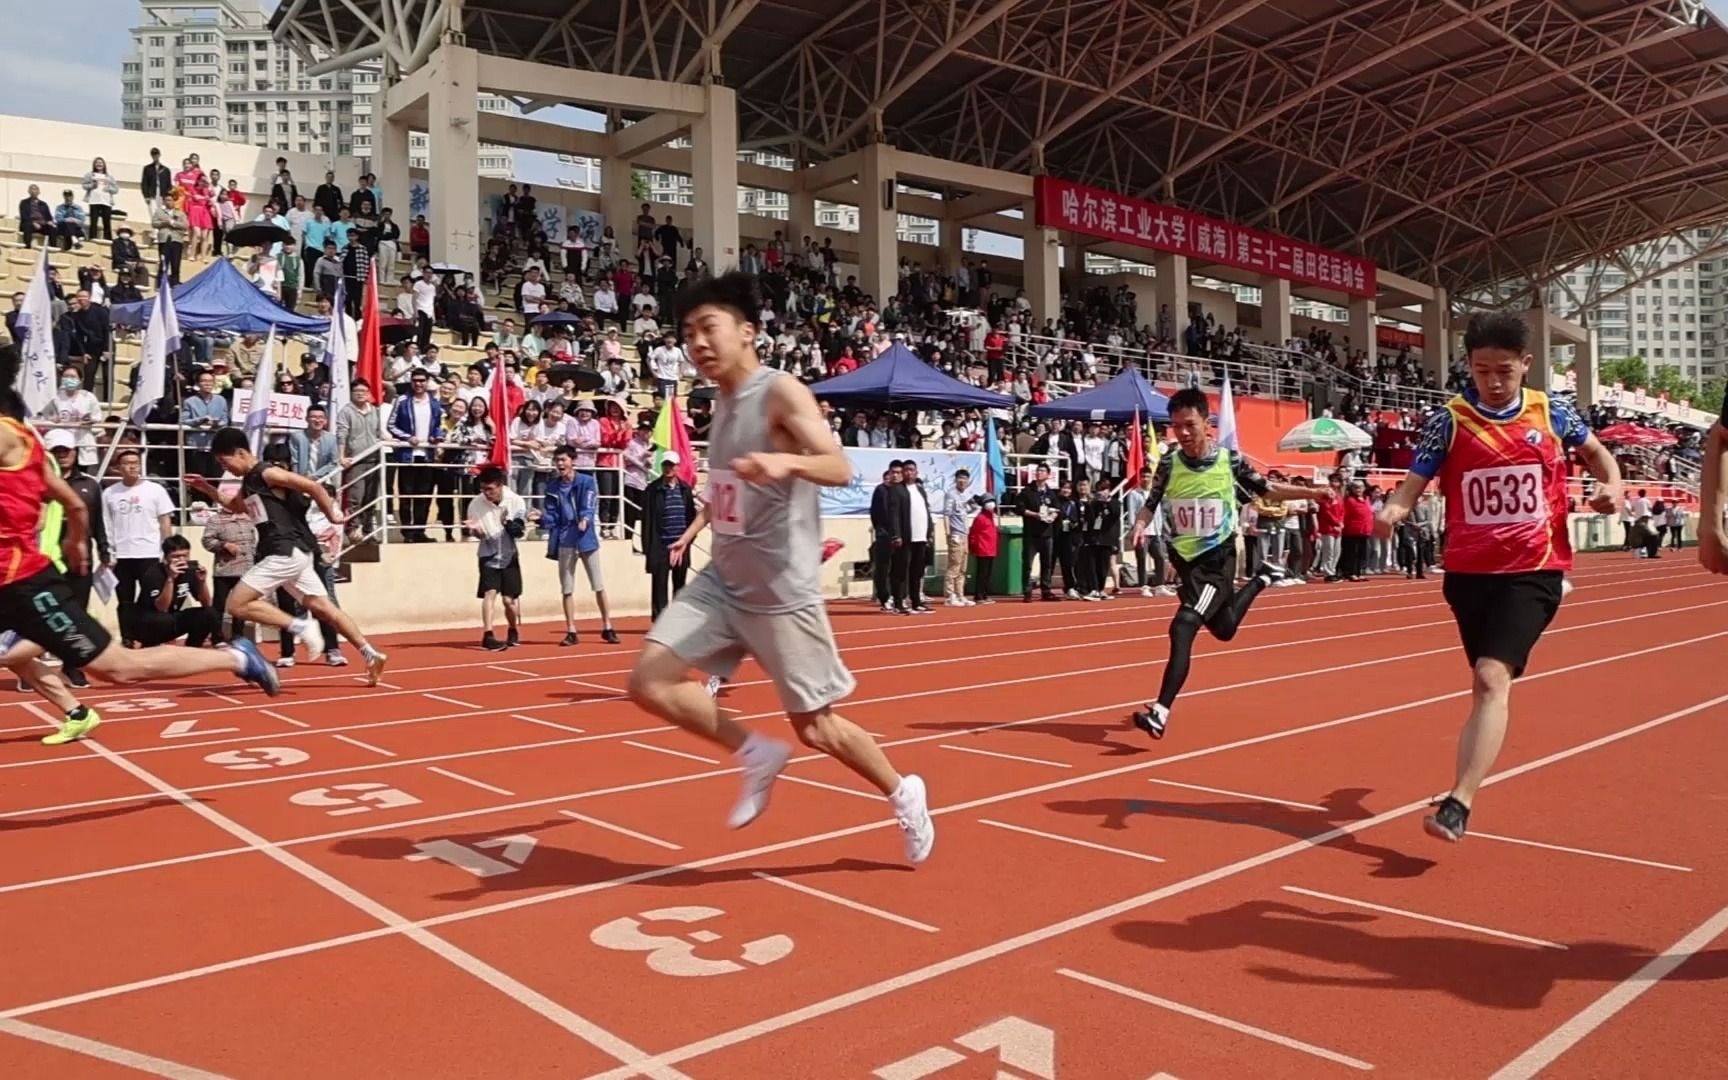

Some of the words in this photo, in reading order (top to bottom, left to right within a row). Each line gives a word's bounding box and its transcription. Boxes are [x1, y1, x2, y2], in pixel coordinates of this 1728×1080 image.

[239, 398, 304, 420] 后保卫处
[1468, 472, 1538, 516] 0533
[1178, 506, 1216, 529] 0711
[590, 905, 795, 977] 3
